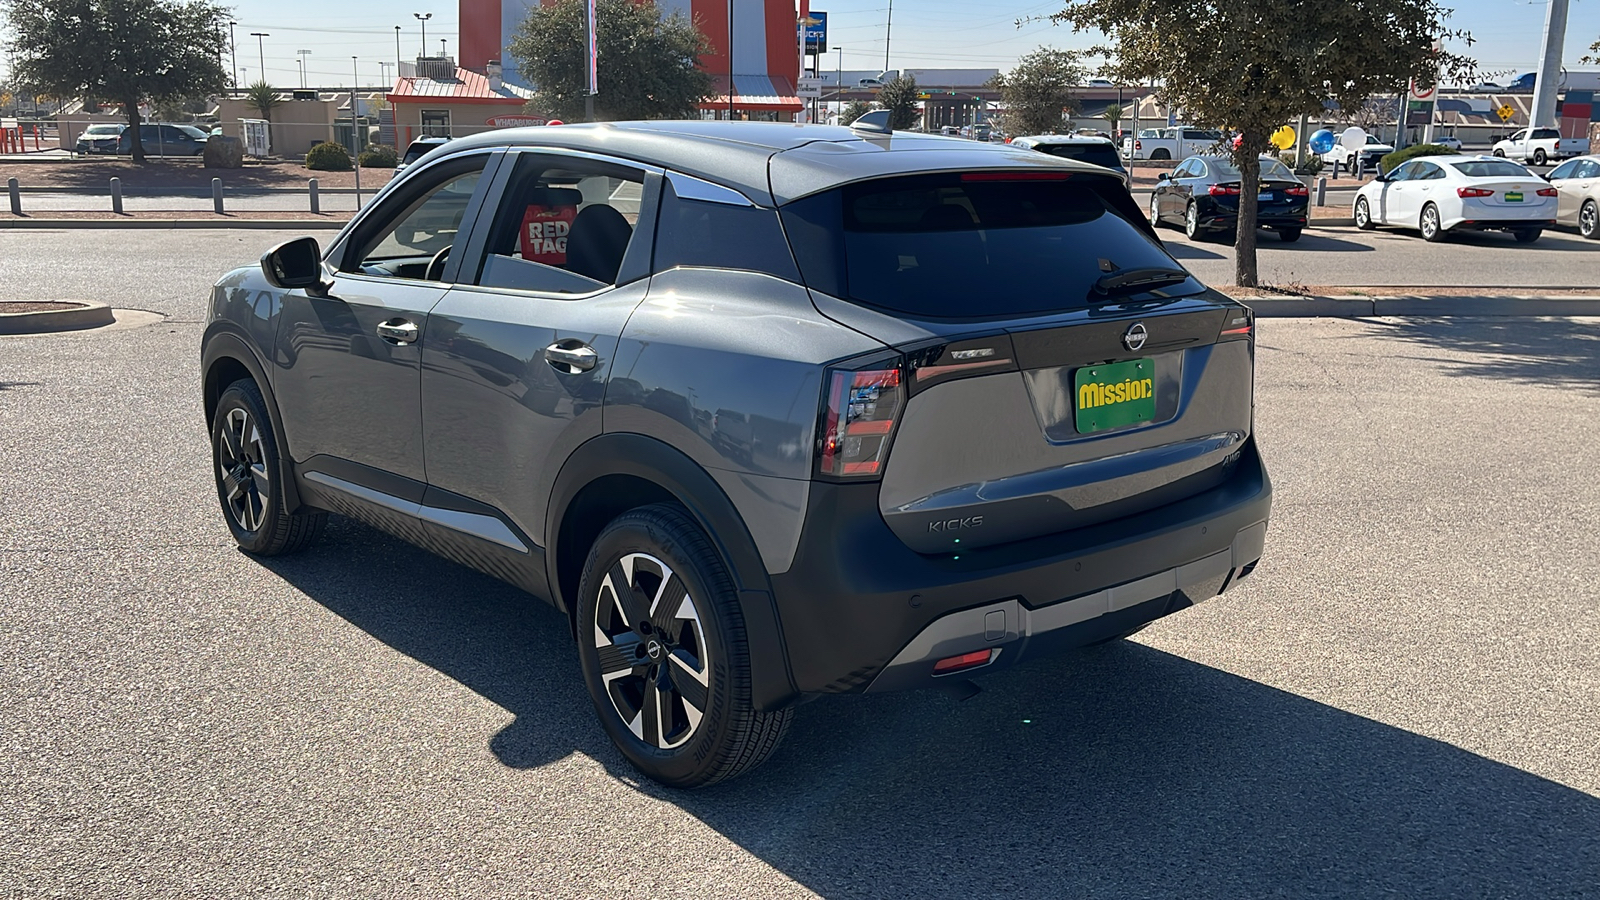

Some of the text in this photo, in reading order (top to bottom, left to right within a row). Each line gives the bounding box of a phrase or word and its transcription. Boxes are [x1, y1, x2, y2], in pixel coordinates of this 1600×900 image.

[494, 118, 545, 128] WHATABURGER
[528, 221, 570, 238] RED
[530, 237, 568, 255] TAG
[1125, 333, 1148, 342] NISSAN
[1079, 378, 1152, 410] Mission
[927, 515, 984, 533] KICKS
